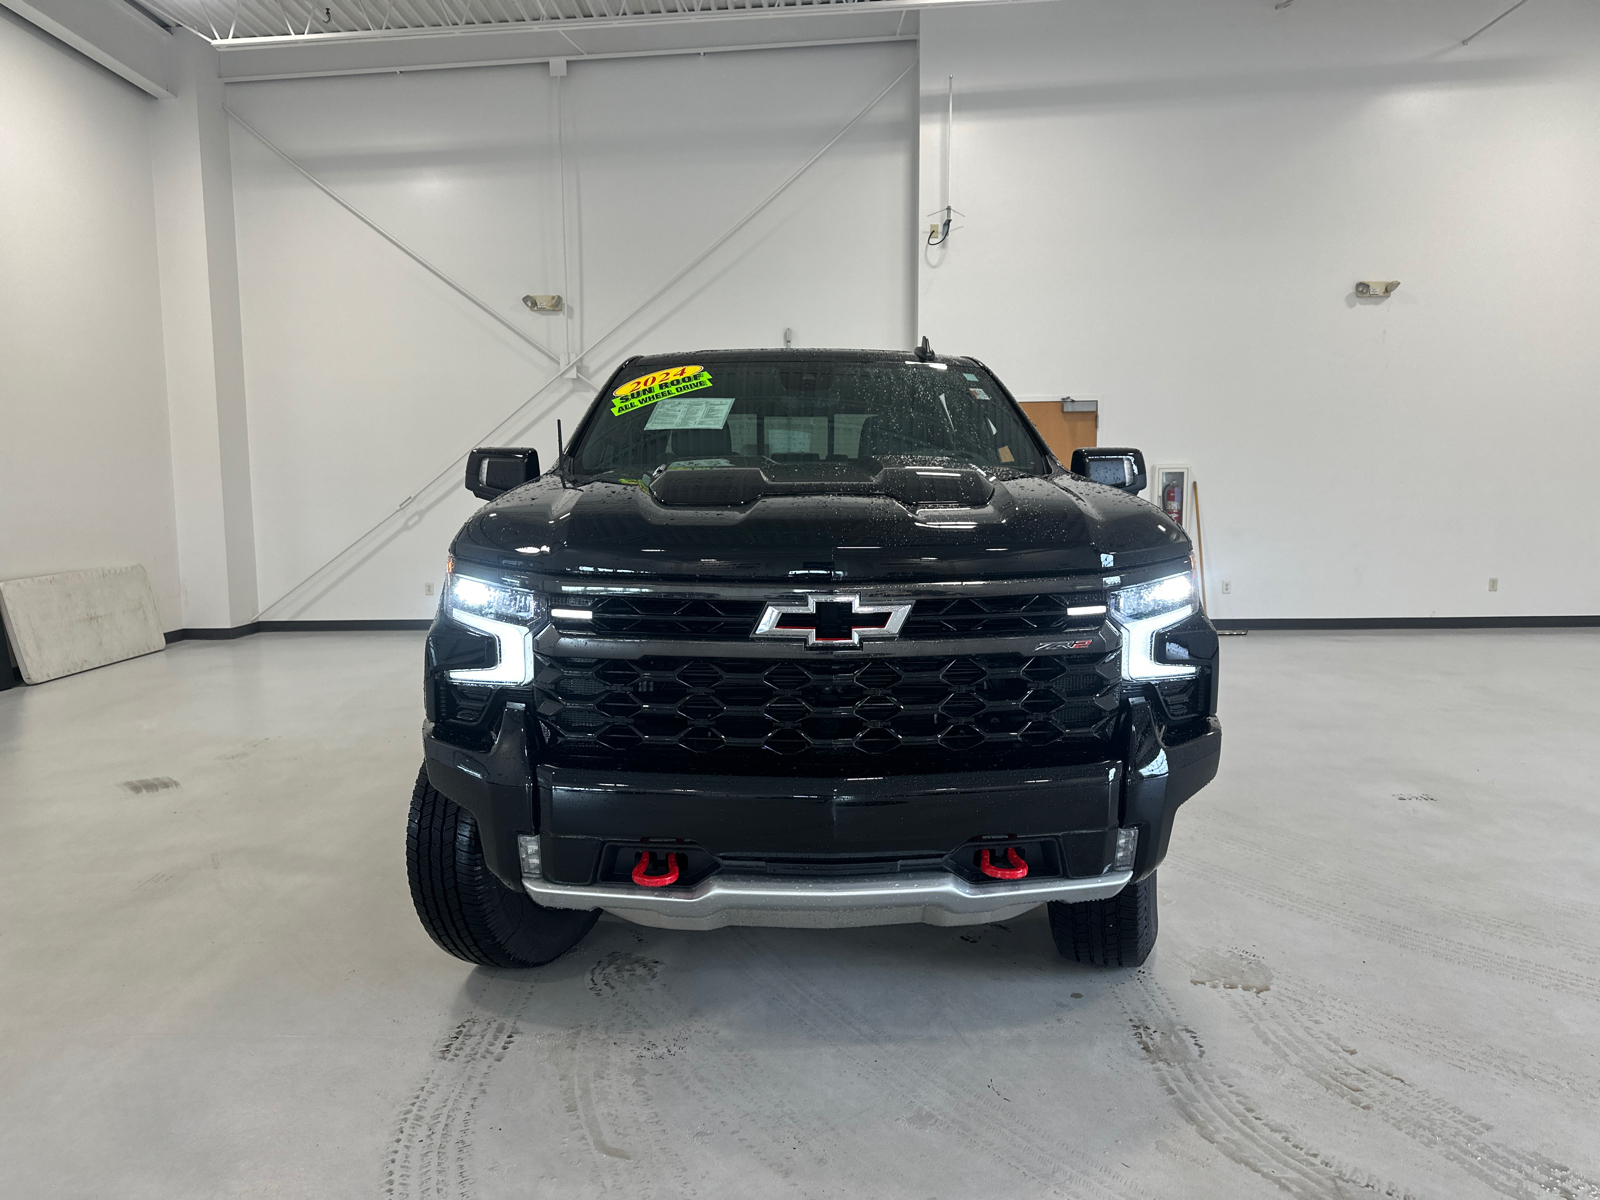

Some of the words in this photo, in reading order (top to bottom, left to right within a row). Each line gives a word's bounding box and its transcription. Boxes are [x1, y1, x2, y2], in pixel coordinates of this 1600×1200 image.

[619, 387, 655, 404] SUN
[658, 372, 704, 390] ROOF
[630, 367, 687, 393] 2024
[617, 401, 638, 414] ALL
[638, 390, 676, 405] WHEEL
[675, 380, 708, 393] DRIVE
[1032, 639, 1093, 651] ZR2
